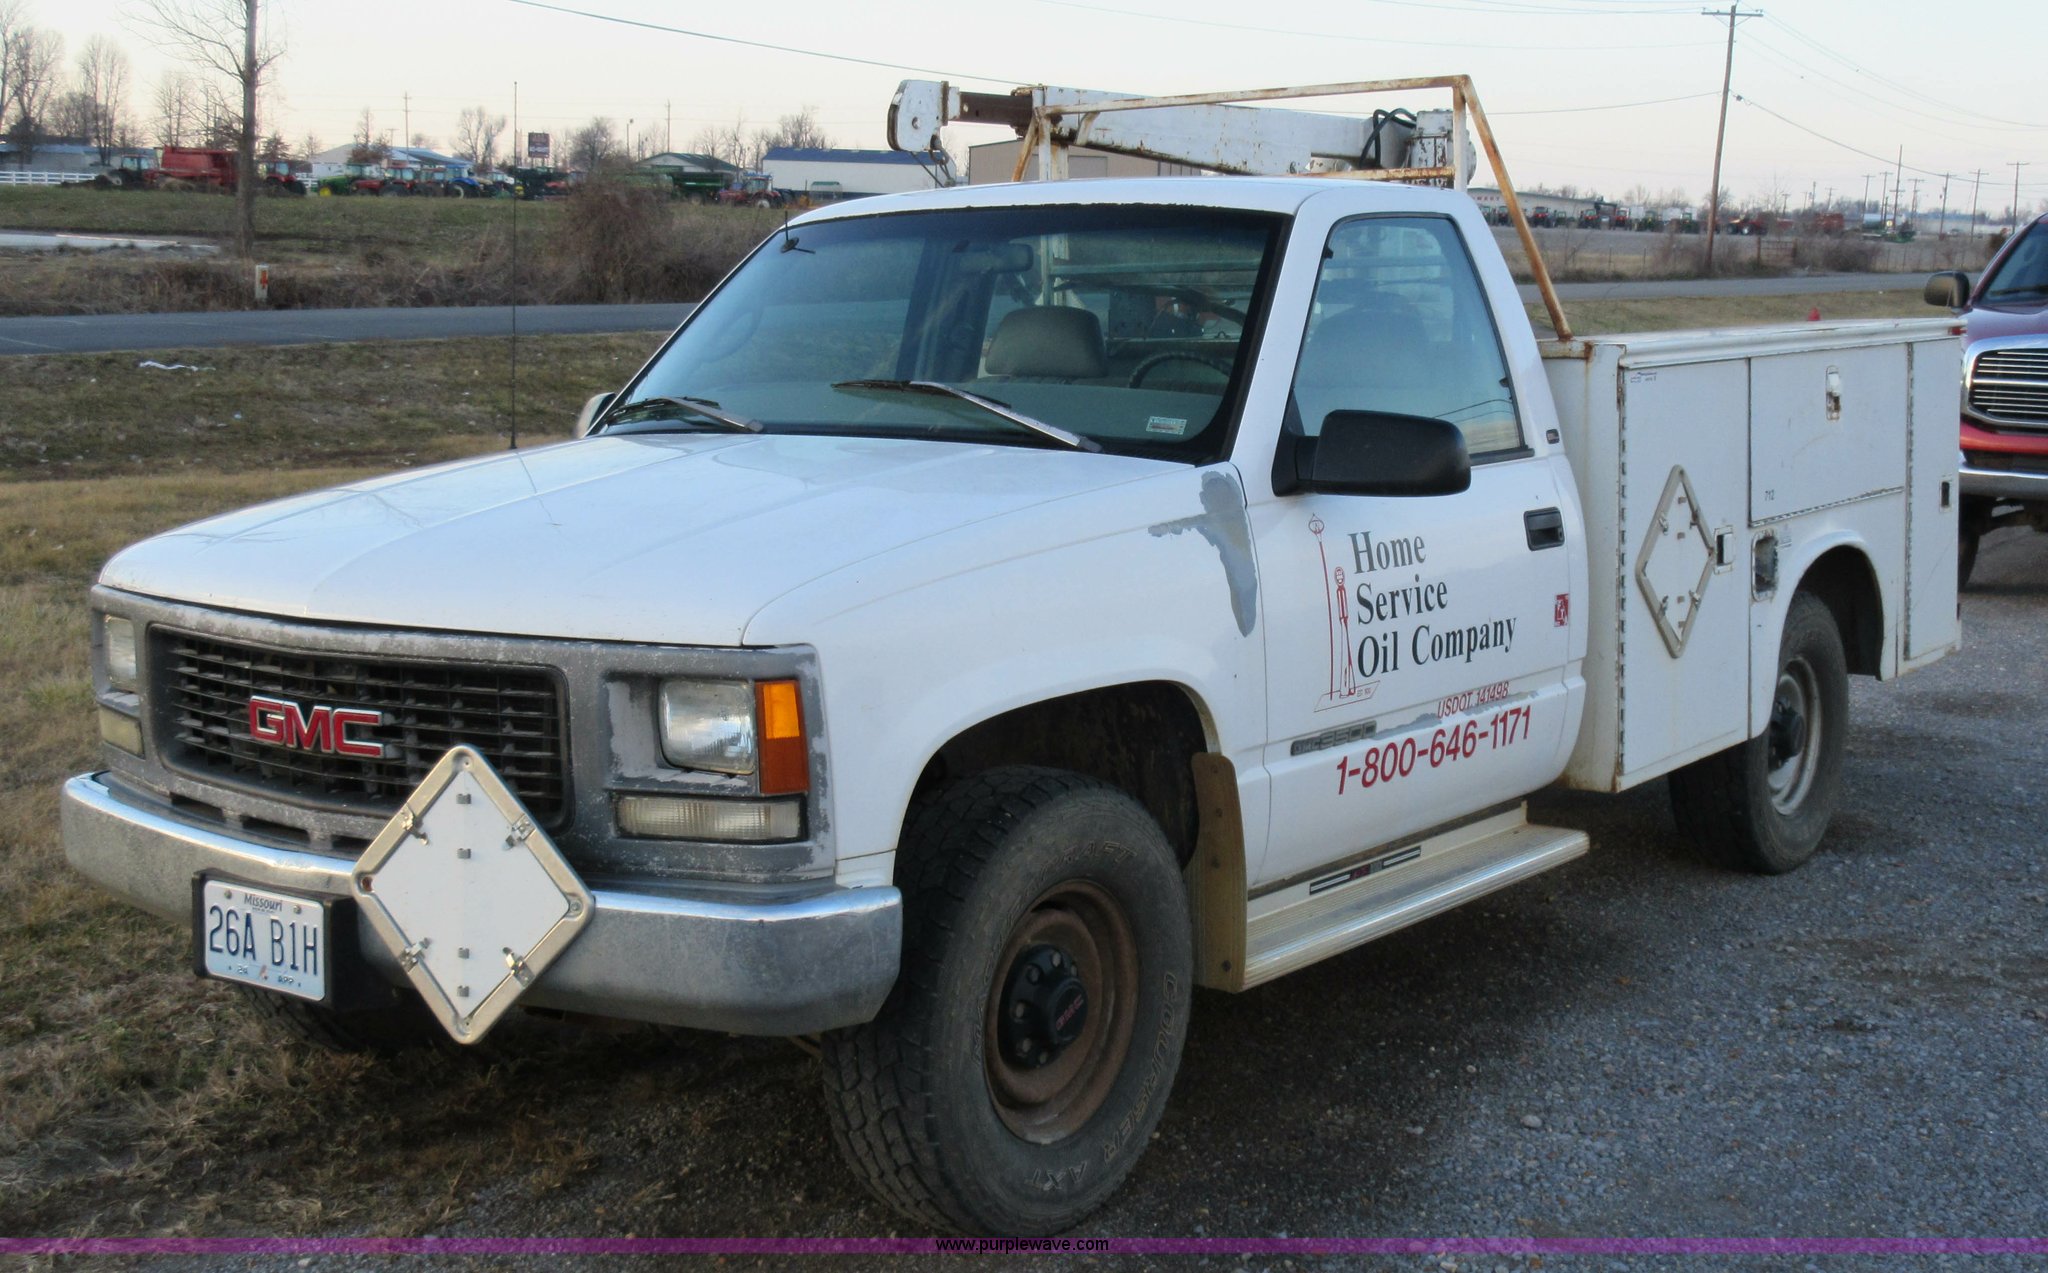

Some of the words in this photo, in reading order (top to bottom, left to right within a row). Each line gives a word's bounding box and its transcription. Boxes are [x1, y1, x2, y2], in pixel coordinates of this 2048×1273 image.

[1348, 531, 1427, 575] Home
[1356, 573, 1448, 625] Service
[1357, 630, 1400, 678] Oil
[1411, 617, 1517, 666] Company
[249, 695, 384, 759] GMC
[1336, 705, 1531, 795] 1-800-646-1171
[244, 893, 283, 912] Missouri
[209, 905, 256, 961] 26A
[270, 918, 318, 976] B1H
[1056, 993, 1084, 1031] GMC
